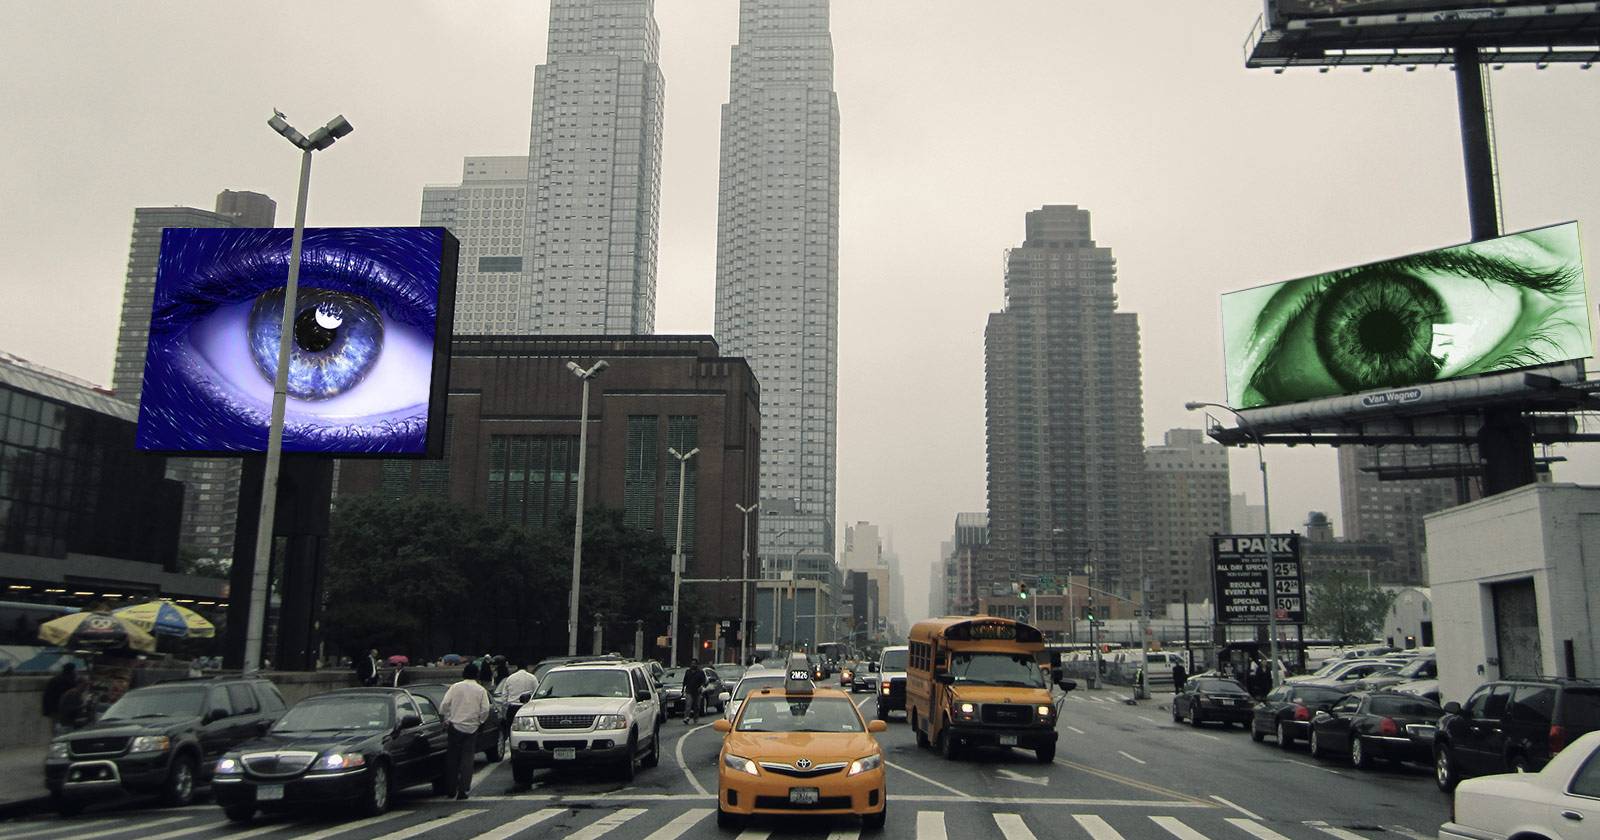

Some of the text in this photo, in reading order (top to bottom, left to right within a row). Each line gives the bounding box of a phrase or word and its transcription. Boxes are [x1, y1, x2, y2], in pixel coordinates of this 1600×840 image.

[1369, 391, 1418, 403] Van Wagner
[1238, 538, 1293, 552] PARK
[1275, 563, 1289, 576] 25
[1277, 581, 1290, 593] 42
[1279, 599, 1292, 610] 50
[792, 671, 808, 679] 2M26
